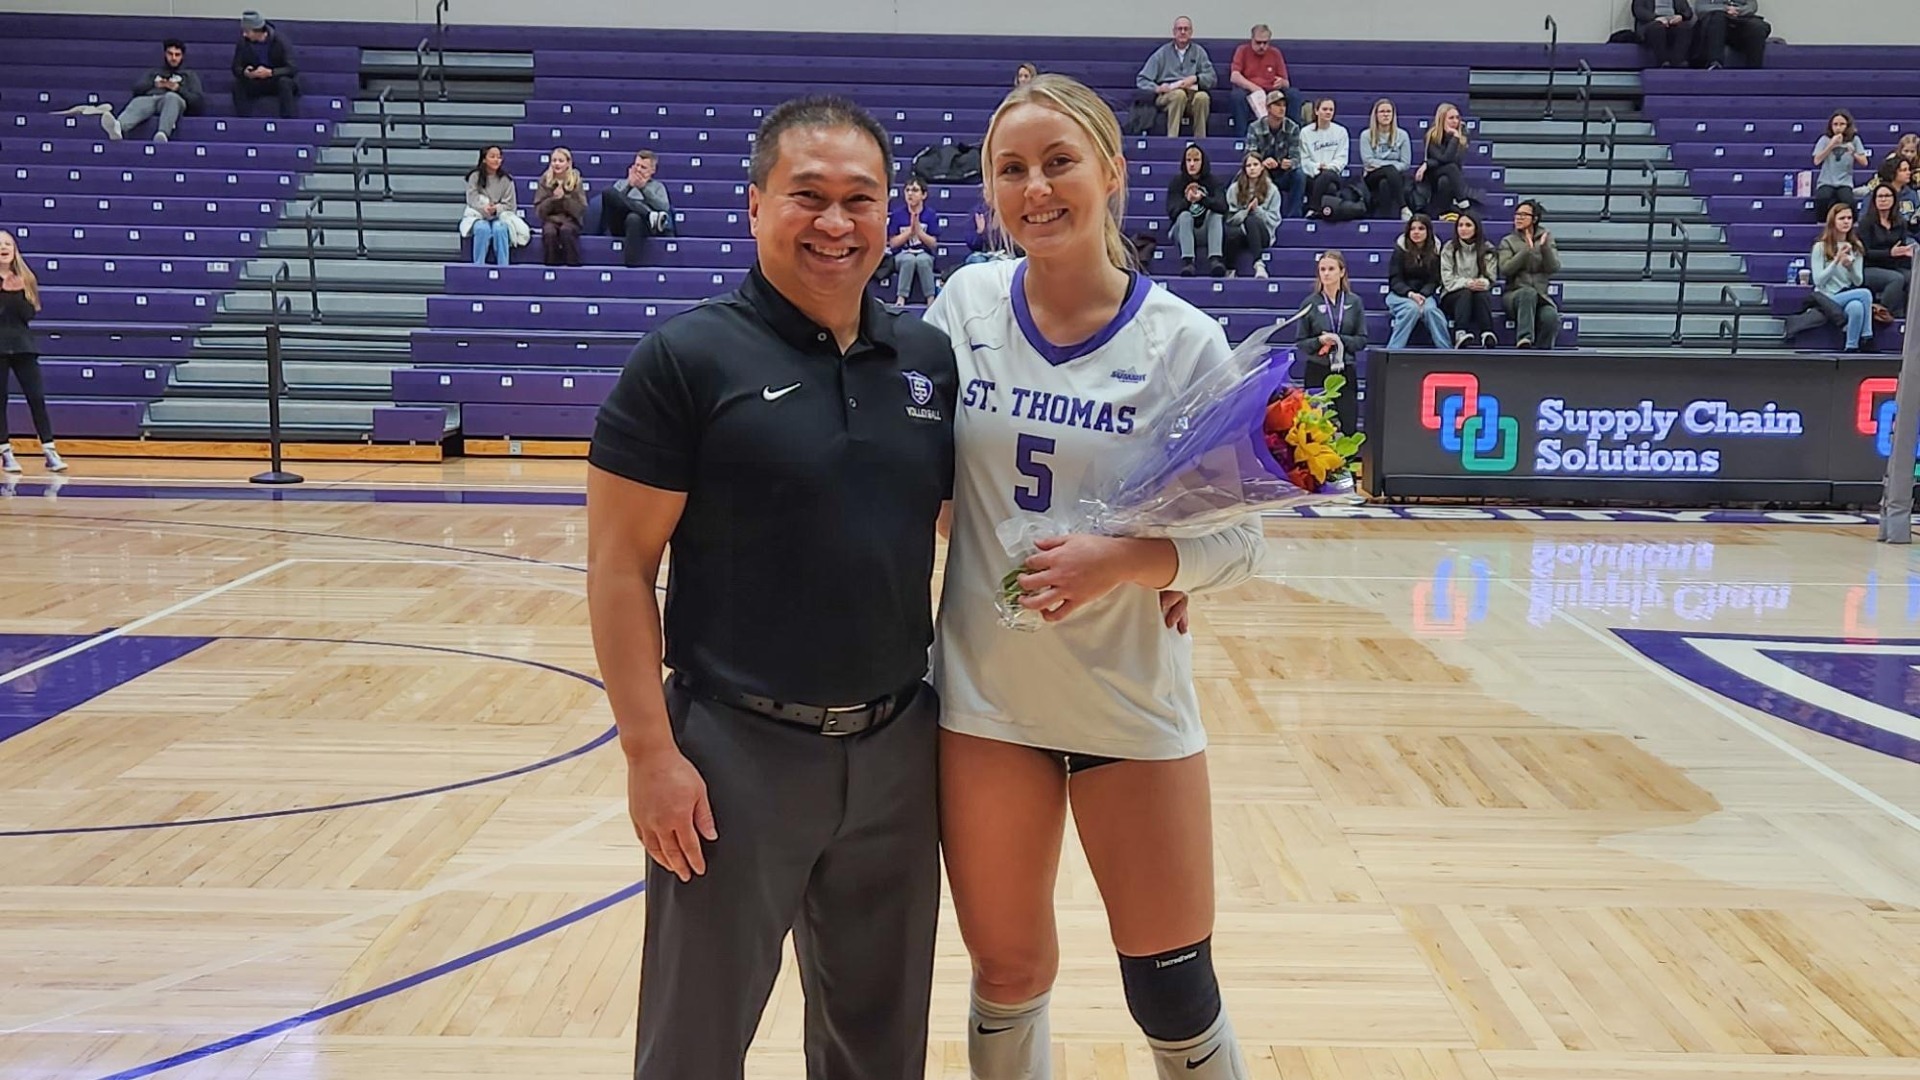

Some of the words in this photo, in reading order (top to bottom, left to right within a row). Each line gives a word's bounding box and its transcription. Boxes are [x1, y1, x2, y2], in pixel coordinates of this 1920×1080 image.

[963, 378, 998, 413] ST.
[1011, 386, 1137, 436] THOMAS
[1538, 398, 1679, 441] Supply
[1684, 400, 1803, 434] Chain
[1014, 432, 1056, 513] 5
[1536, 438, 1720, 473] Solutions
